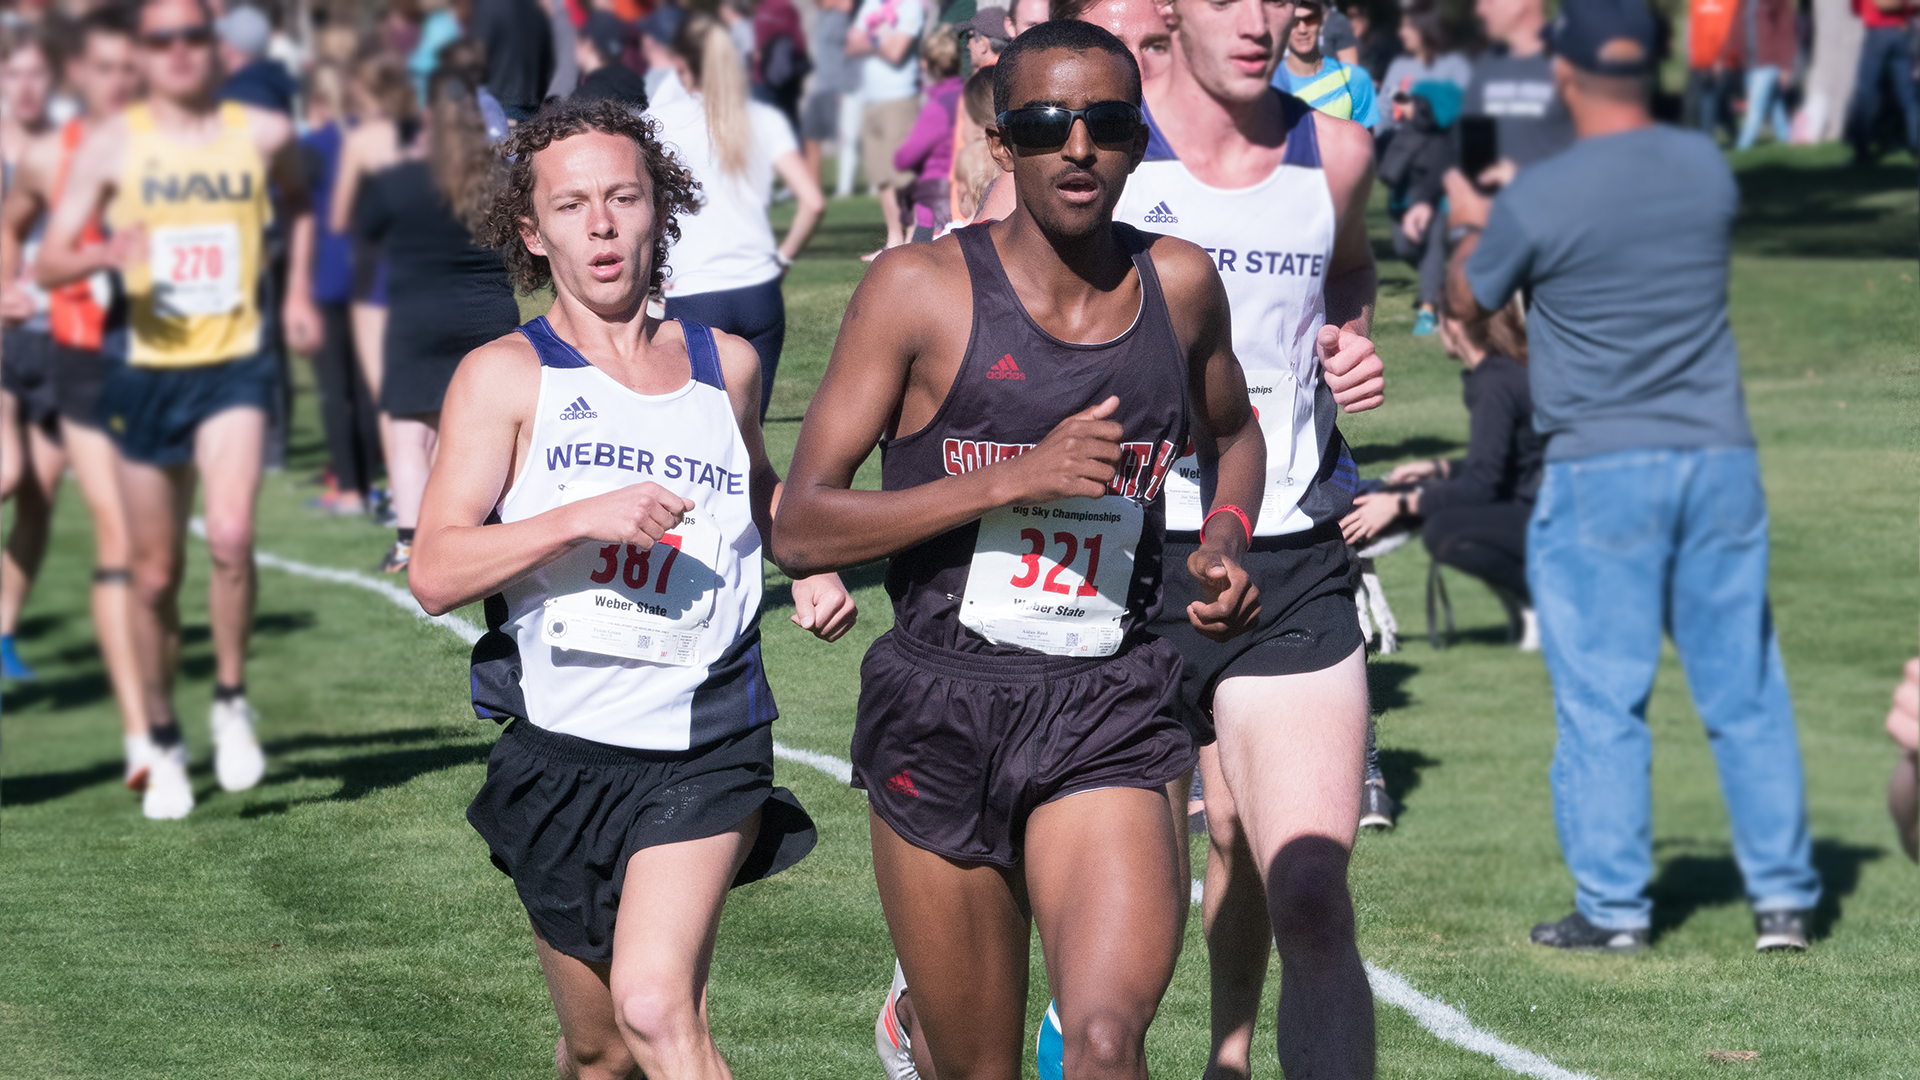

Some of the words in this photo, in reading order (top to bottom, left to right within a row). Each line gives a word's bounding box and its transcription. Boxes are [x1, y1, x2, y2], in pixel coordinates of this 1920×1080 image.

[143, 172, 252, 206] NAU
[1143, 213, 1179, 225] adidas
[171, 244, 224, 282] 270
[1245, 250, 1323, 277] STATE
[986, 368, 1026, 381] adidas
[559, 409, 598, 421] adidas
[546, 442, 655, 475] WEBER
[664, 454, 745, 496] STATE
[1031, 506, 1050, 519] Sky
[1052, 508, 1122, 524] Championships
[590, 533, 683, 595] 387
[1010, 528, 1103, 597] 321
[595, 595, 633, 611] Weber
[636, 601, 668, 617] State
[1055, 605, 1086, 618] State
